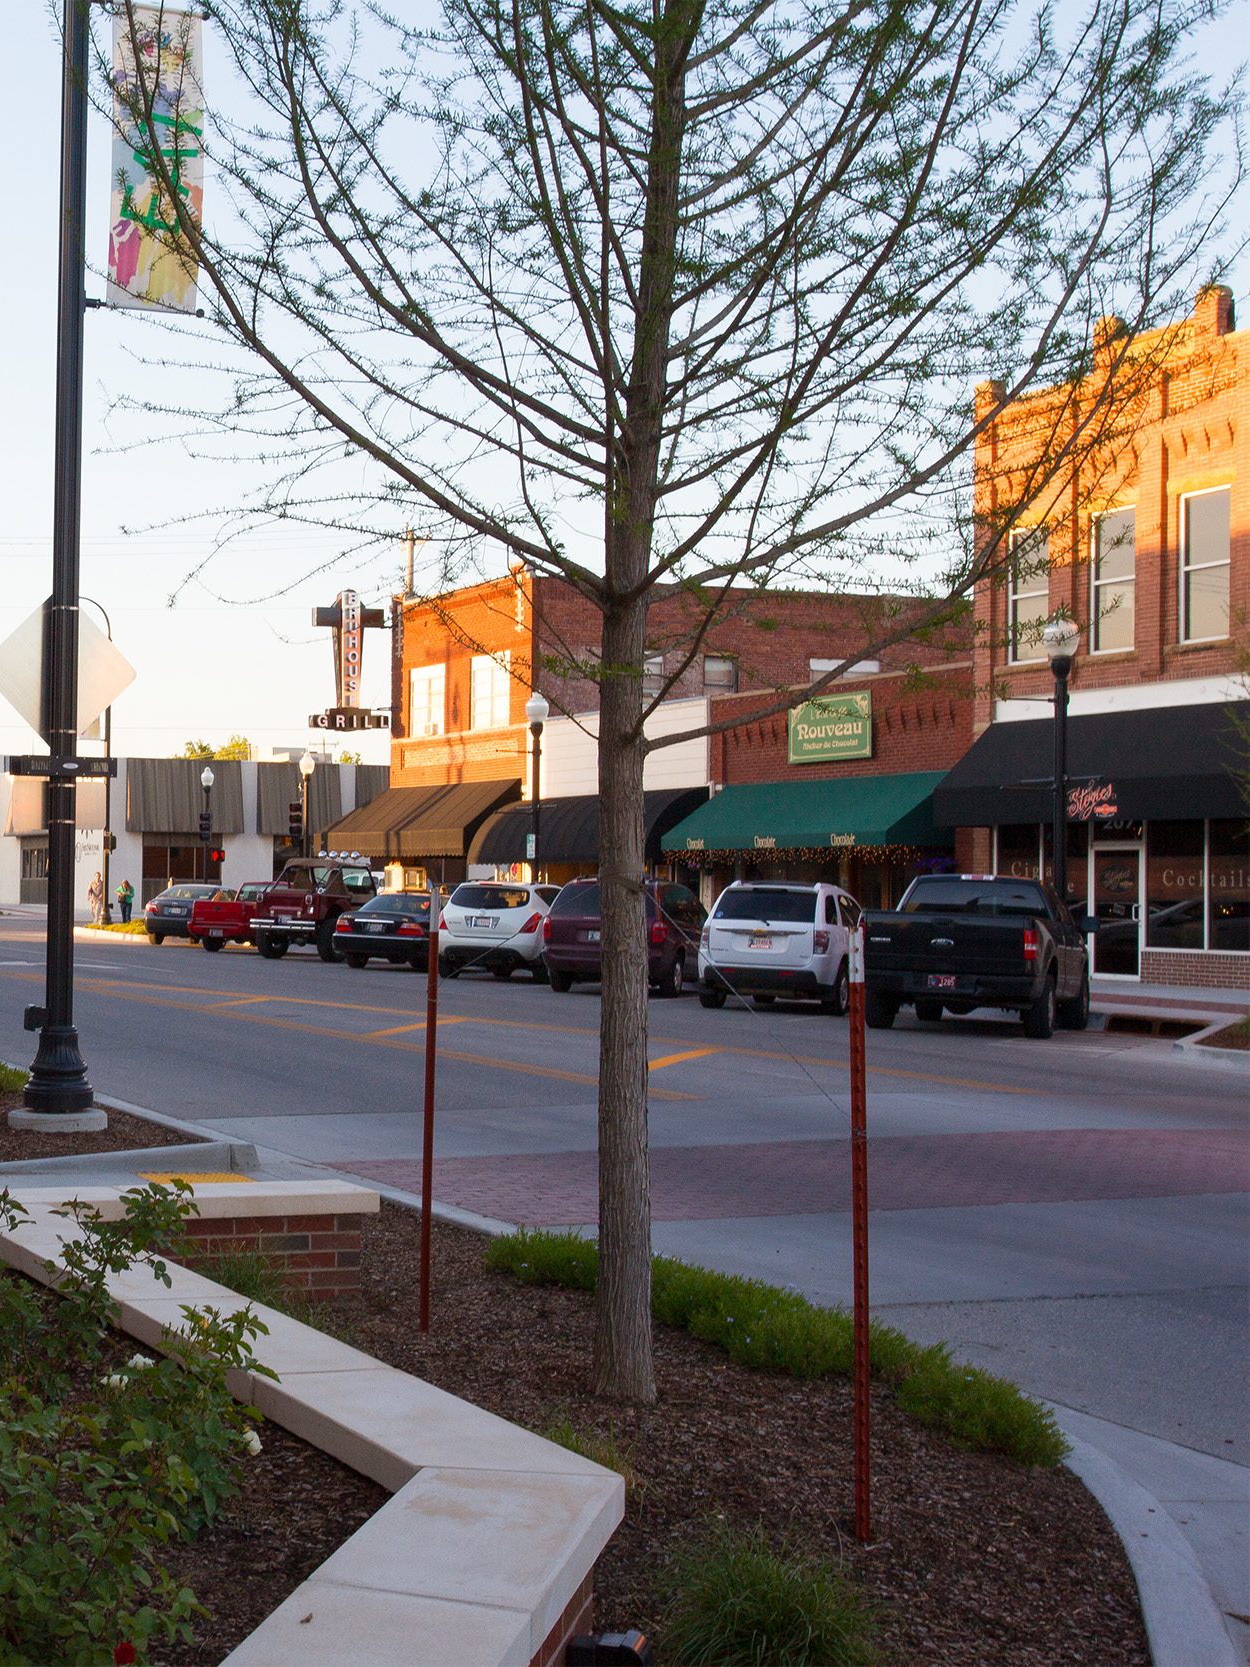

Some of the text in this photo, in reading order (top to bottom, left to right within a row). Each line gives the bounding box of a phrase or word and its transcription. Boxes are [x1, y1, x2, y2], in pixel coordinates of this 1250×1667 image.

[348, 591, 360, 707] BRUHOUSE
[317, 714, 388, 728] GRILL
[797, 722, 862, 740] Nouveau
[1066, 779, 1114, 820] Stogies
